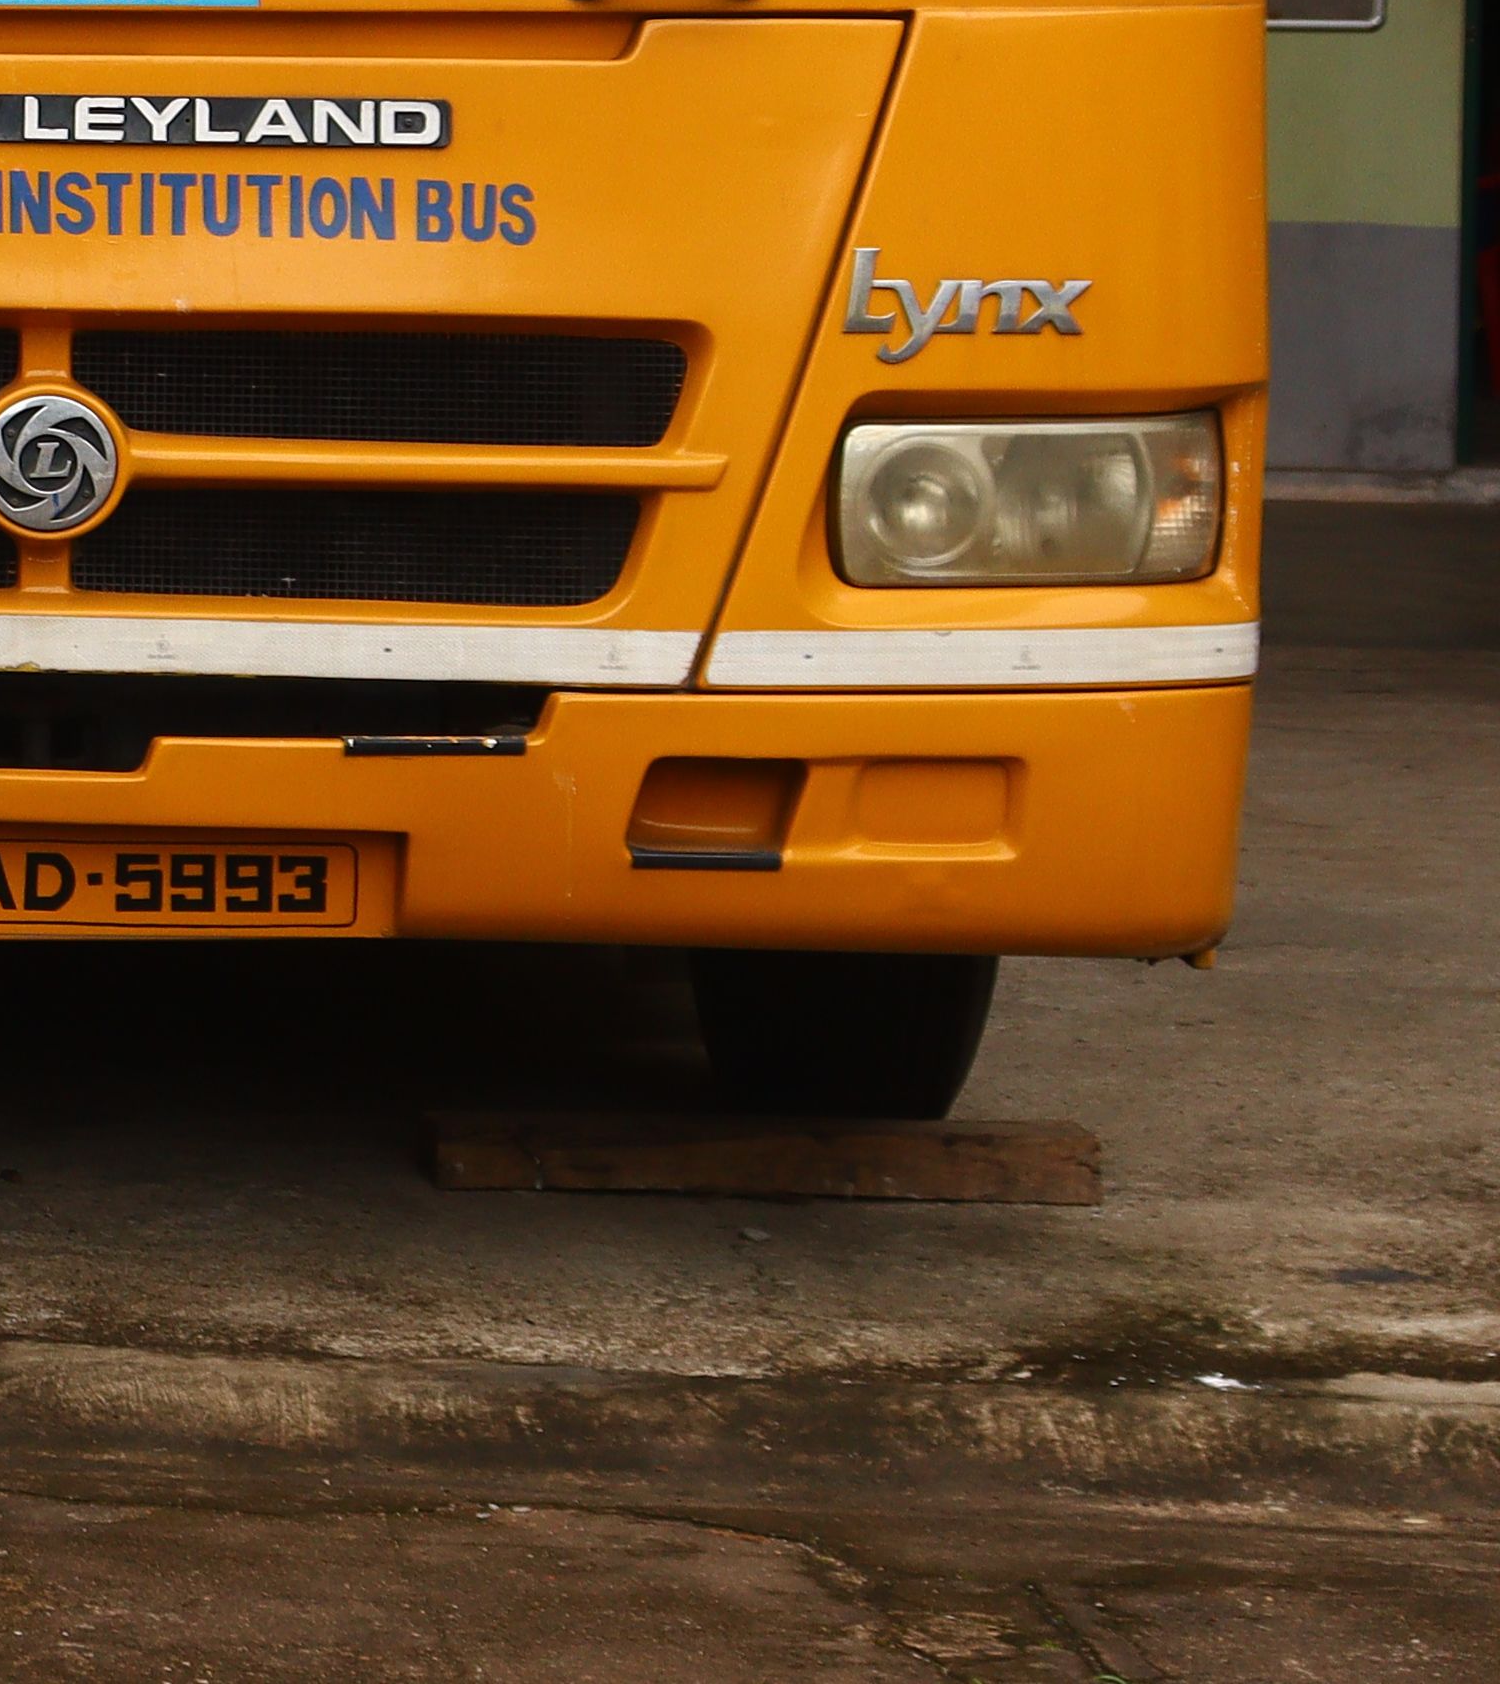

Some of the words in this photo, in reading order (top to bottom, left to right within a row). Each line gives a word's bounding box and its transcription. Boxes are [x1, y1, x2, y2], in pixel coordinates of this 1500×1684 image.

[24, 96, 444, 146] LEYLAND
[414, 179, 537, 247] BUS
[841, 247, 1093, 365] Lynx
